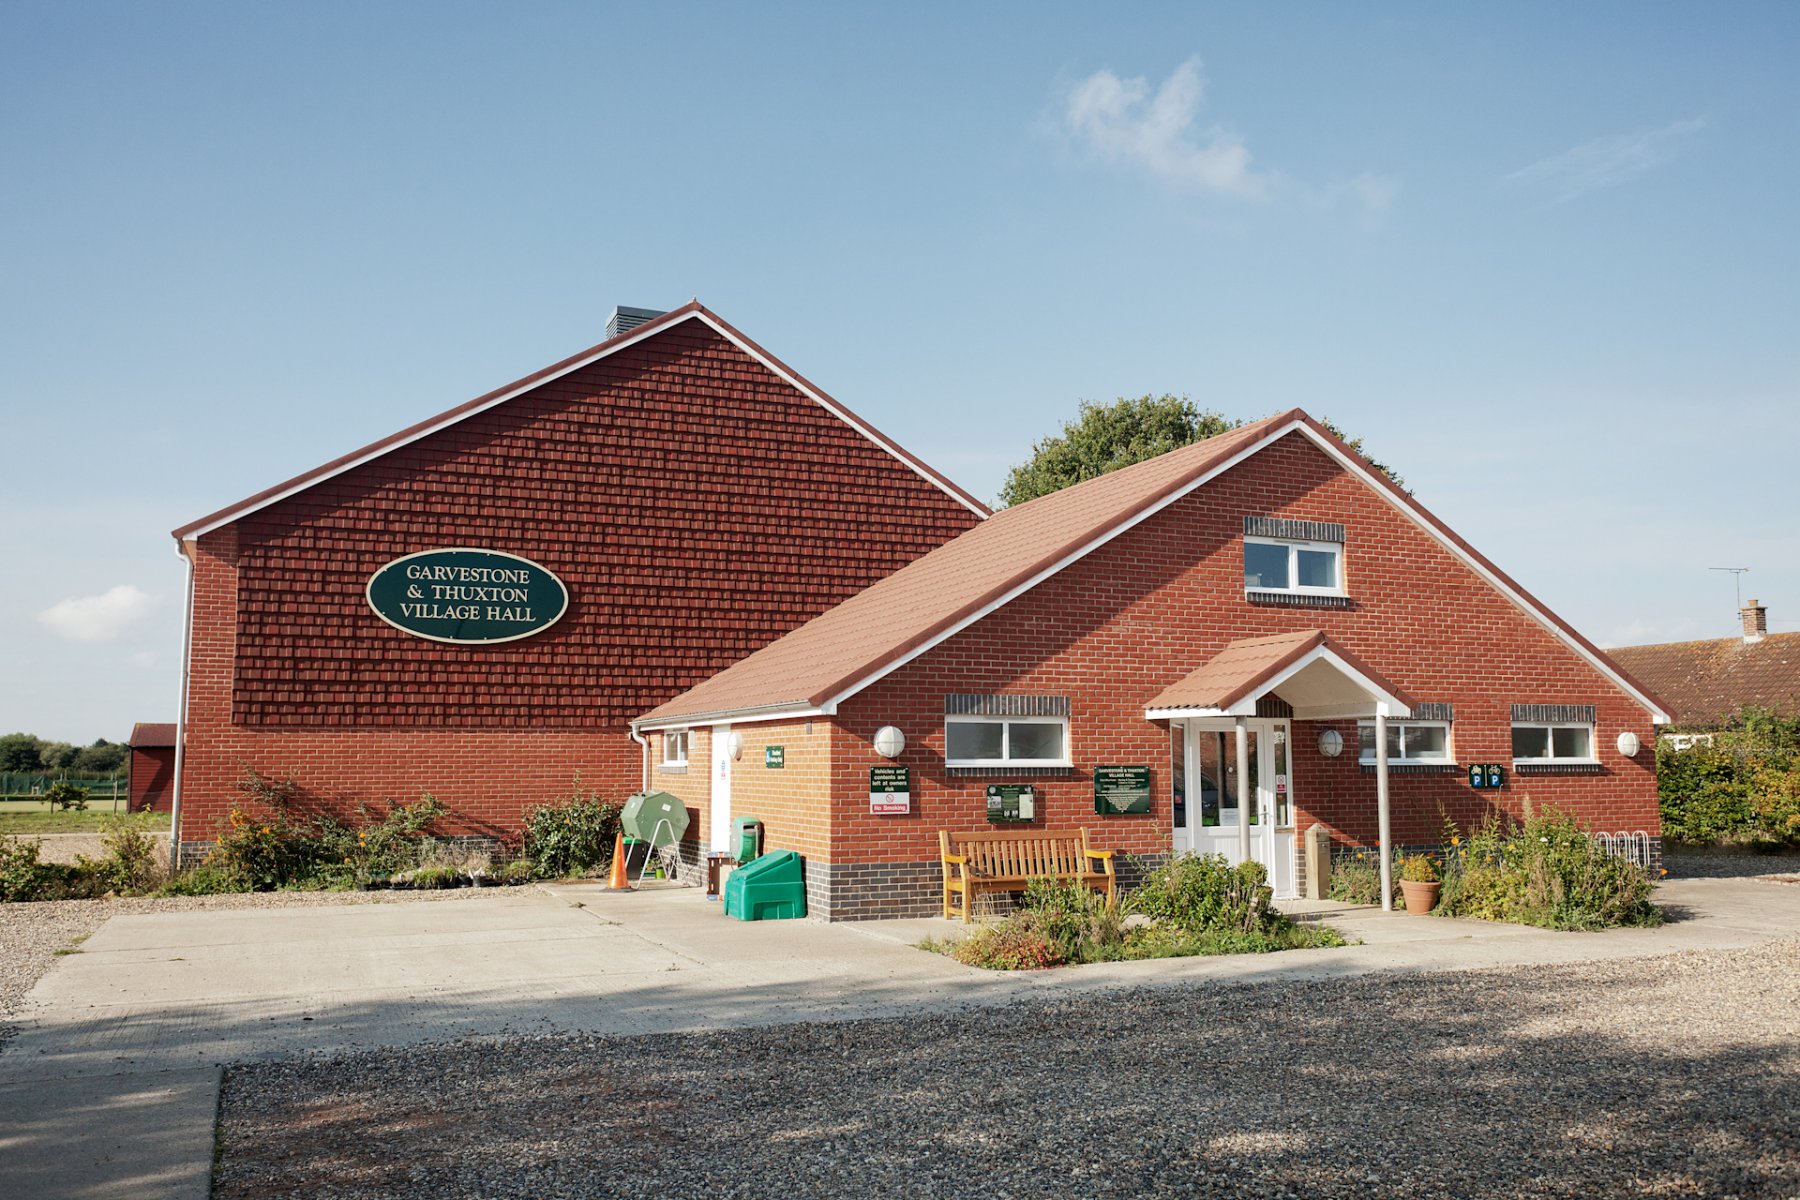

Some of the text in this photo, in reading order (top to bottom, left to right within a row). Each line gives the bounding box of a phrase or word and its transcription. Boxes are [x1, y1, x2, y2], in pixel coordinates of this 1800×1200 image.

[406, 564, 530, 584] GARVESTONE
[406, 584, 529, 602] & THUXTON
[400, 603, 536, 622] VILLAGE HALL
[1474, 776, 1480, 785] P
[1492, 776, 1498, 785] P
